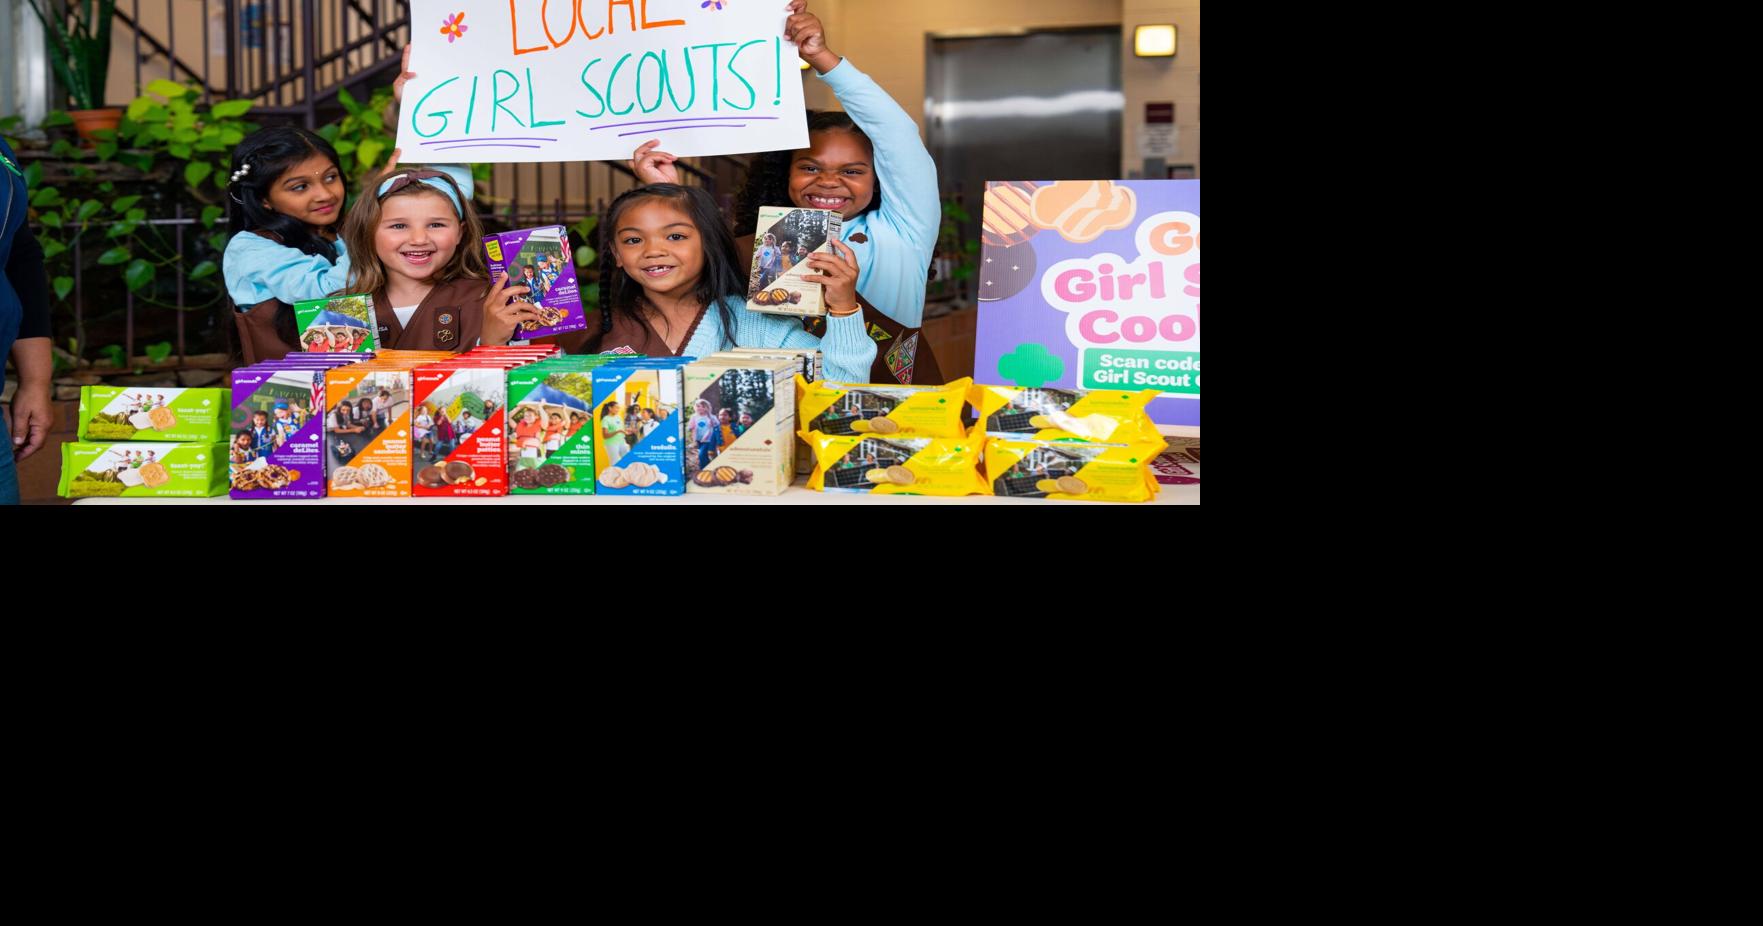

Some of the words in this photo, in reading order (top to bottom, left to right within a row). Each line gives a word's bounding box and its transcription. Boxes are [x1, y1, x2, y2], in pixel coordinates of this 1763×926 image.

[412, 68, 566, 138] GIRL
[576, 36, 781, 119] SCOUTS!
[1149, 221, 1200, 256] G
[1054, 261, 1167, 302] Girl
[1079, 303, 1200, 344] Coo
[1093, 369, 1129, 383] Girl
[1133, 371, 1191, 387] Scout
[1100, 354, 1149, 369] Scan
